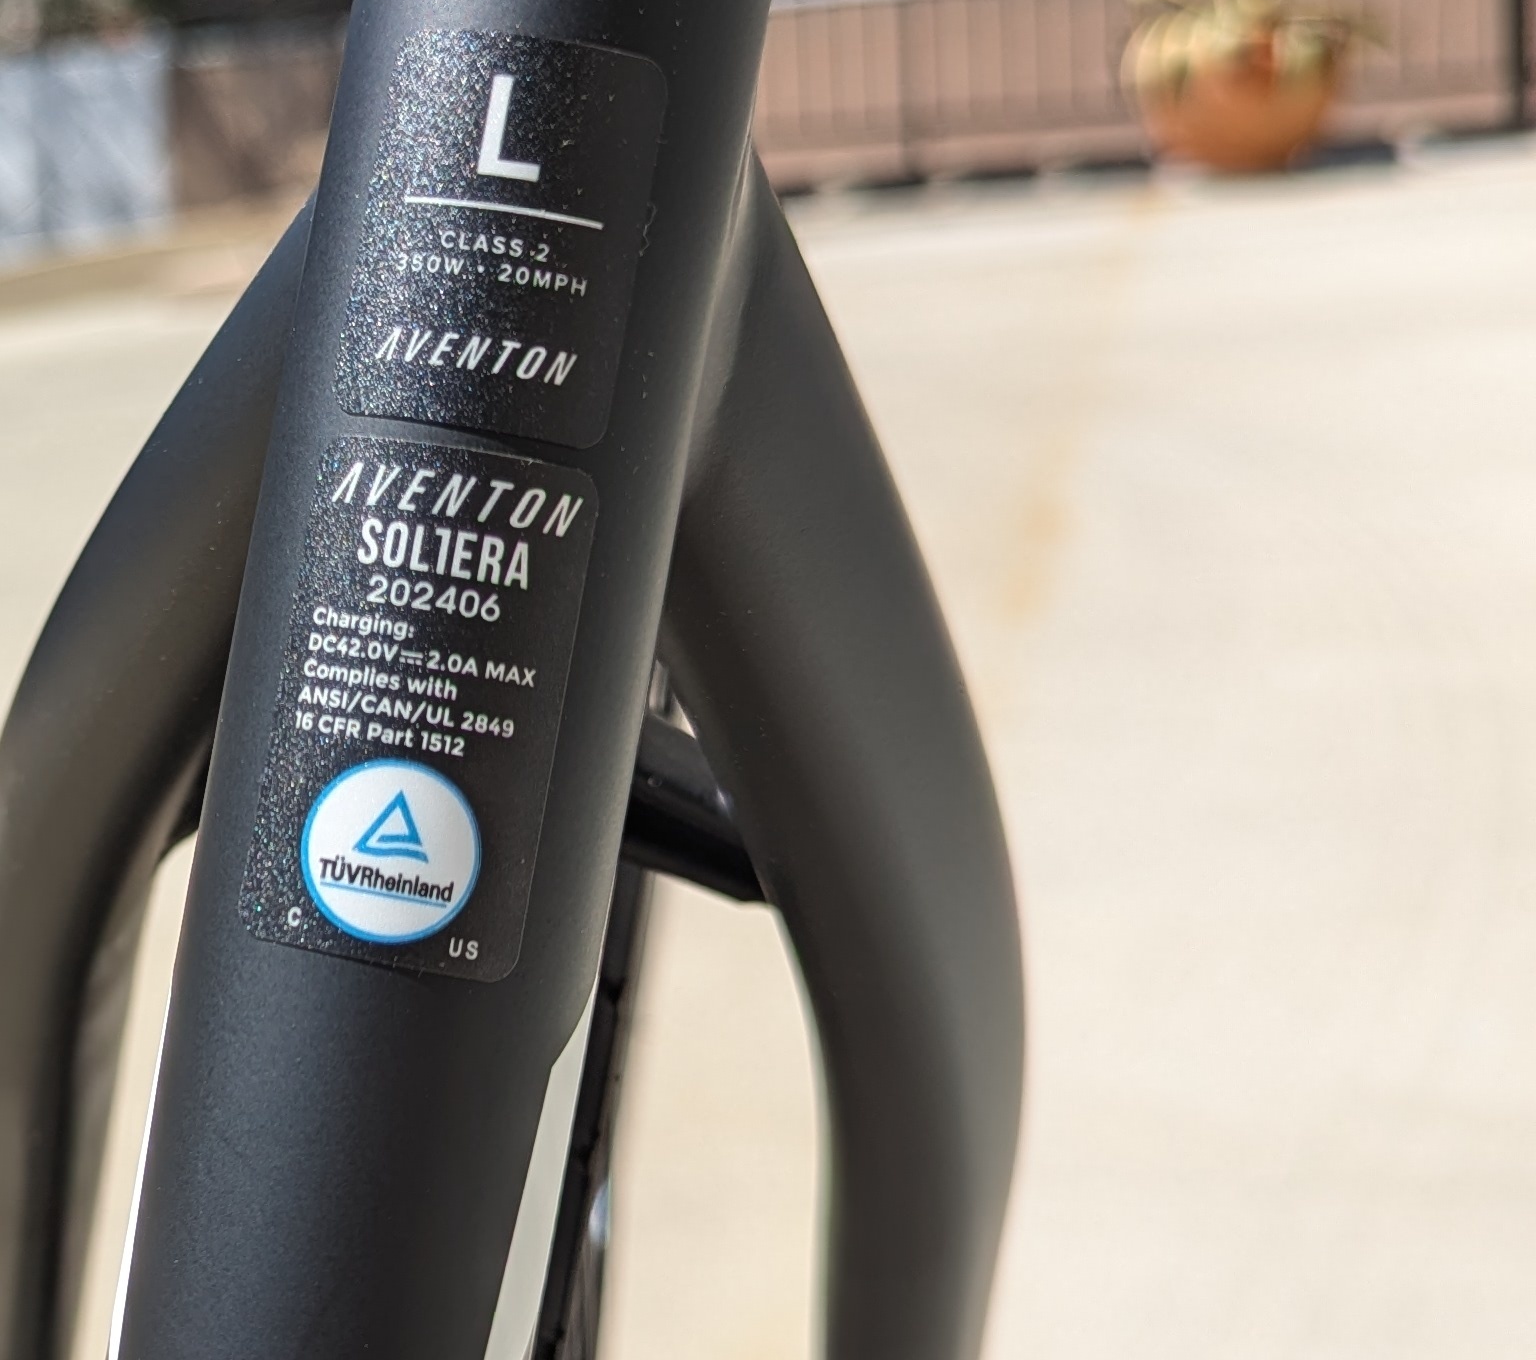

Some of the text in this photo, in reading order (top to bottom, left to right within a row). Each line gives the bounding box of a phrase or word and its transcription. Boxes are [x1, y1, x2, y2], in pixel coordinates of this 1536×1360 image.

[477, 74, 541, 182] L
[440, 230, 551, 262] CLASS 2
[396, 253, 588, 297] 350W 20MPH
[375, 327, 578, 387] AVENTON
[331, 461, 584, 538] AVENTON
[357, 516, 529, 591] SOLTERA
[366, 573, 501, 622] 202406
[312, 606, 415, 640] Charging:
[303, 660, 458, 701] Complies with
[484, 660, 537, 688] MAX
[295, 710, 466, 757] 16 CFR Part 1512
[298, 685, 515, 738] ANSI/CAN/UL 2849
[287, 906, 302, 928] C
[448, 937, 479, 961] US
